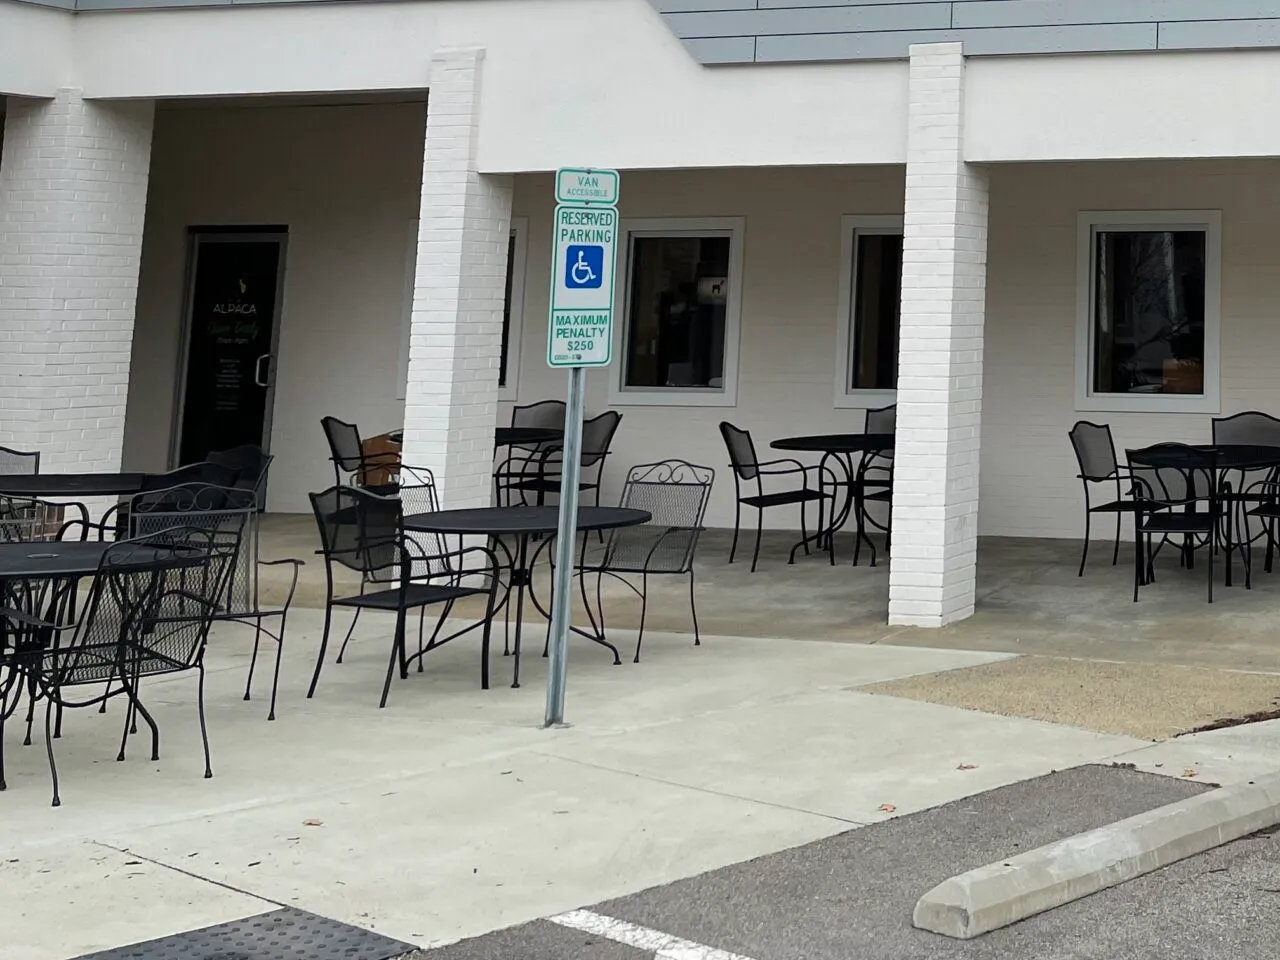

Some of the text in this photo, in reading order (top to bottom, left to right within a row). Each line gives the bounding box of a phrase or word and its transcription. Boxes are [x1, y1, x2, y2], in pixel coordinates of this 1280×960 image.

[578, 176, 599, 188] VAN
[567, 188, 608, 197] ACCESSIBLE
[561, 212, 613, 226] RESERVED
[561, 229, 611, 243] PARKING
[213, 304, 257, 314] ALPACA
[556, 315, 608, 326] MAXIMUM
[556, 327, 605, 339] PENALTY
[567, 341, 594, 351] $250
